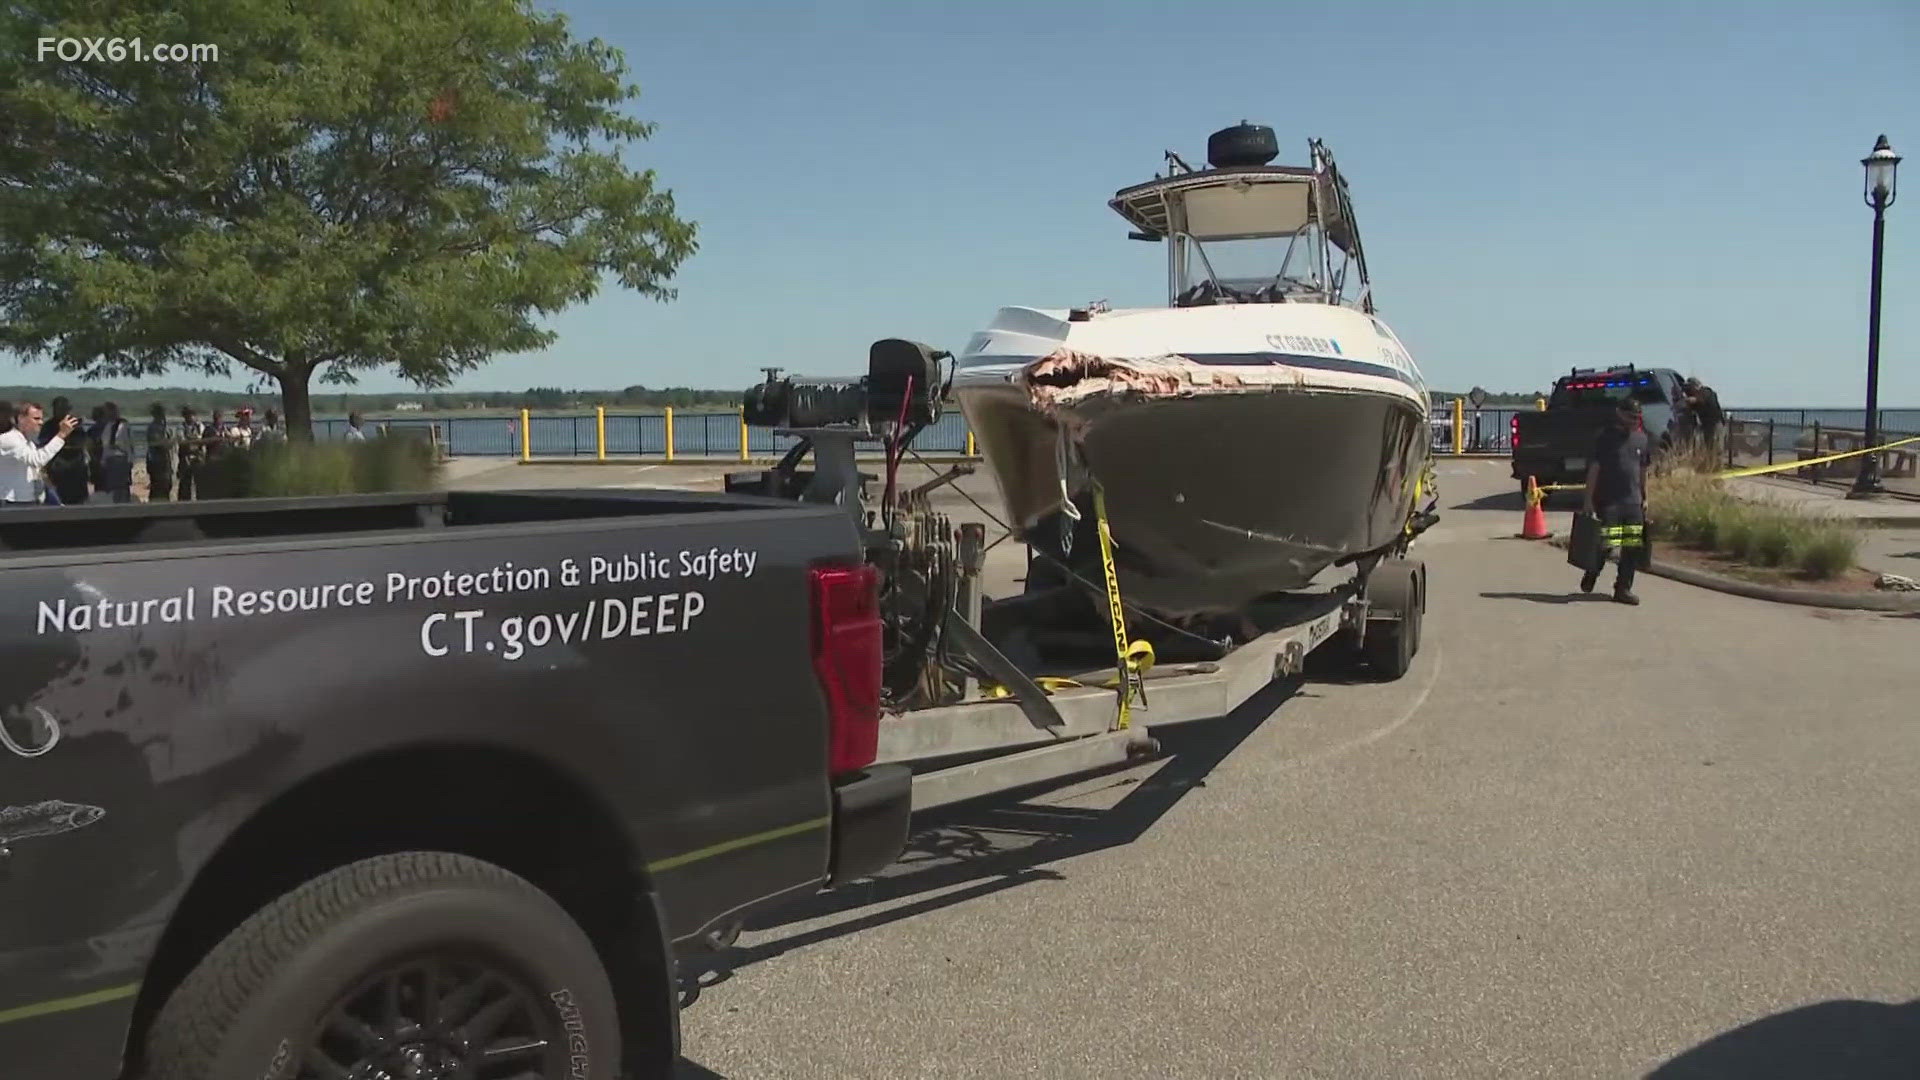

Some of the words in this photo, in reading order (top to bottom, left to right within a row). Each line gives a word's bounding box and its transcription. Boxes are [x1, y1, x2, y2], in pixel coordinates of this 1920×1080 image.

[36, 586, 195, 635] Natural
[211, 581, 375, 619] Resource
[386, 561, 551, 602] Protection
[560, 558, 580, 587] &
[590, 551, 671, 584] Public
[679, 547, 758, 581] Safety
[420, 590, 706, 660] CT.gov/DEEP
[1106, 560, 1127, 653] VULCAN
